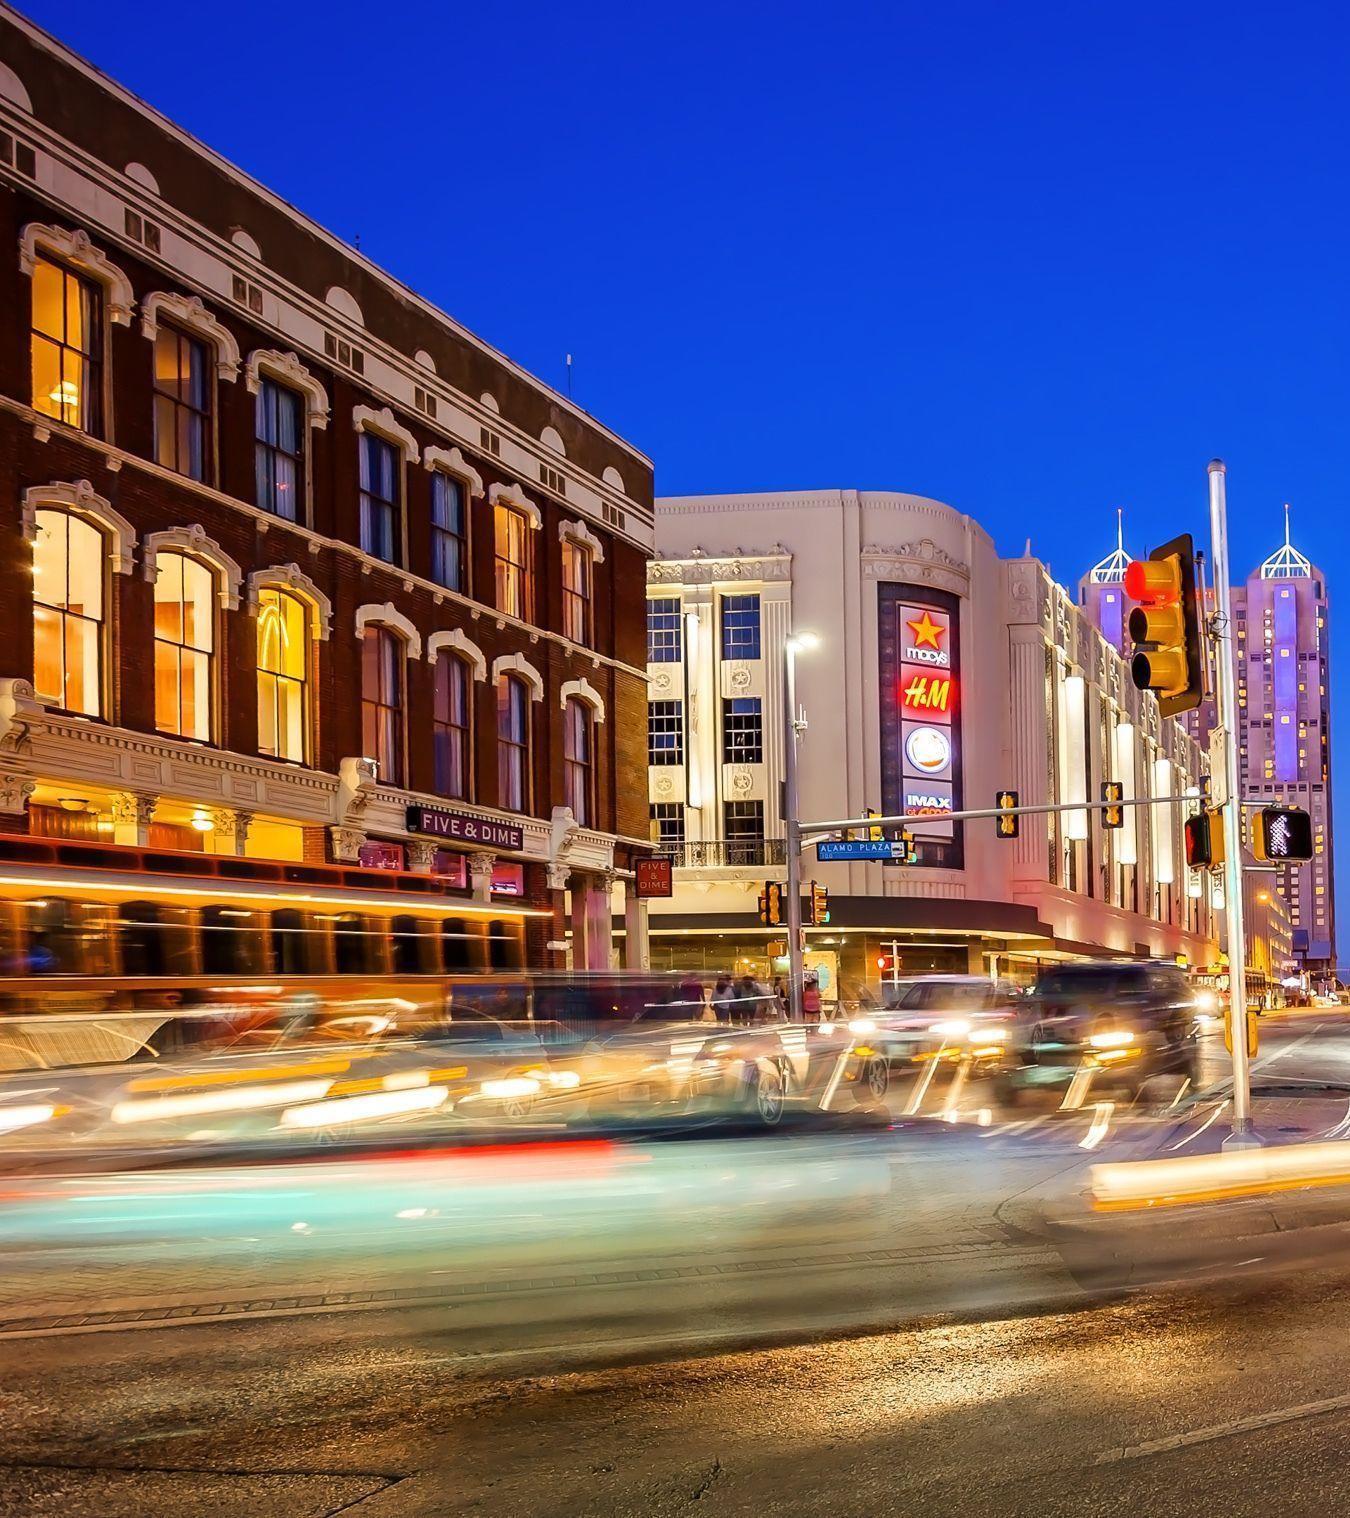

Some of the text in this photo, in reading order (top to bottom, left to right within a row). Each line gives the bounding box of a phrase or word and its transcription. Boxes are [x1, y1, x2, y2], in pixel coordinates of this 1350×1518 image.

[906, 647, 948, 665] macy's
[904, 676, 950, 711] H&M
[907, 794, 951, 809] IMAX
[423, 813, 519, 846] FIVE & DIME
[820, 842, 890, 853] ALAMO PLAZA
[650, 872, 658, 880] &
[640, 881, 668, 889] DIME
